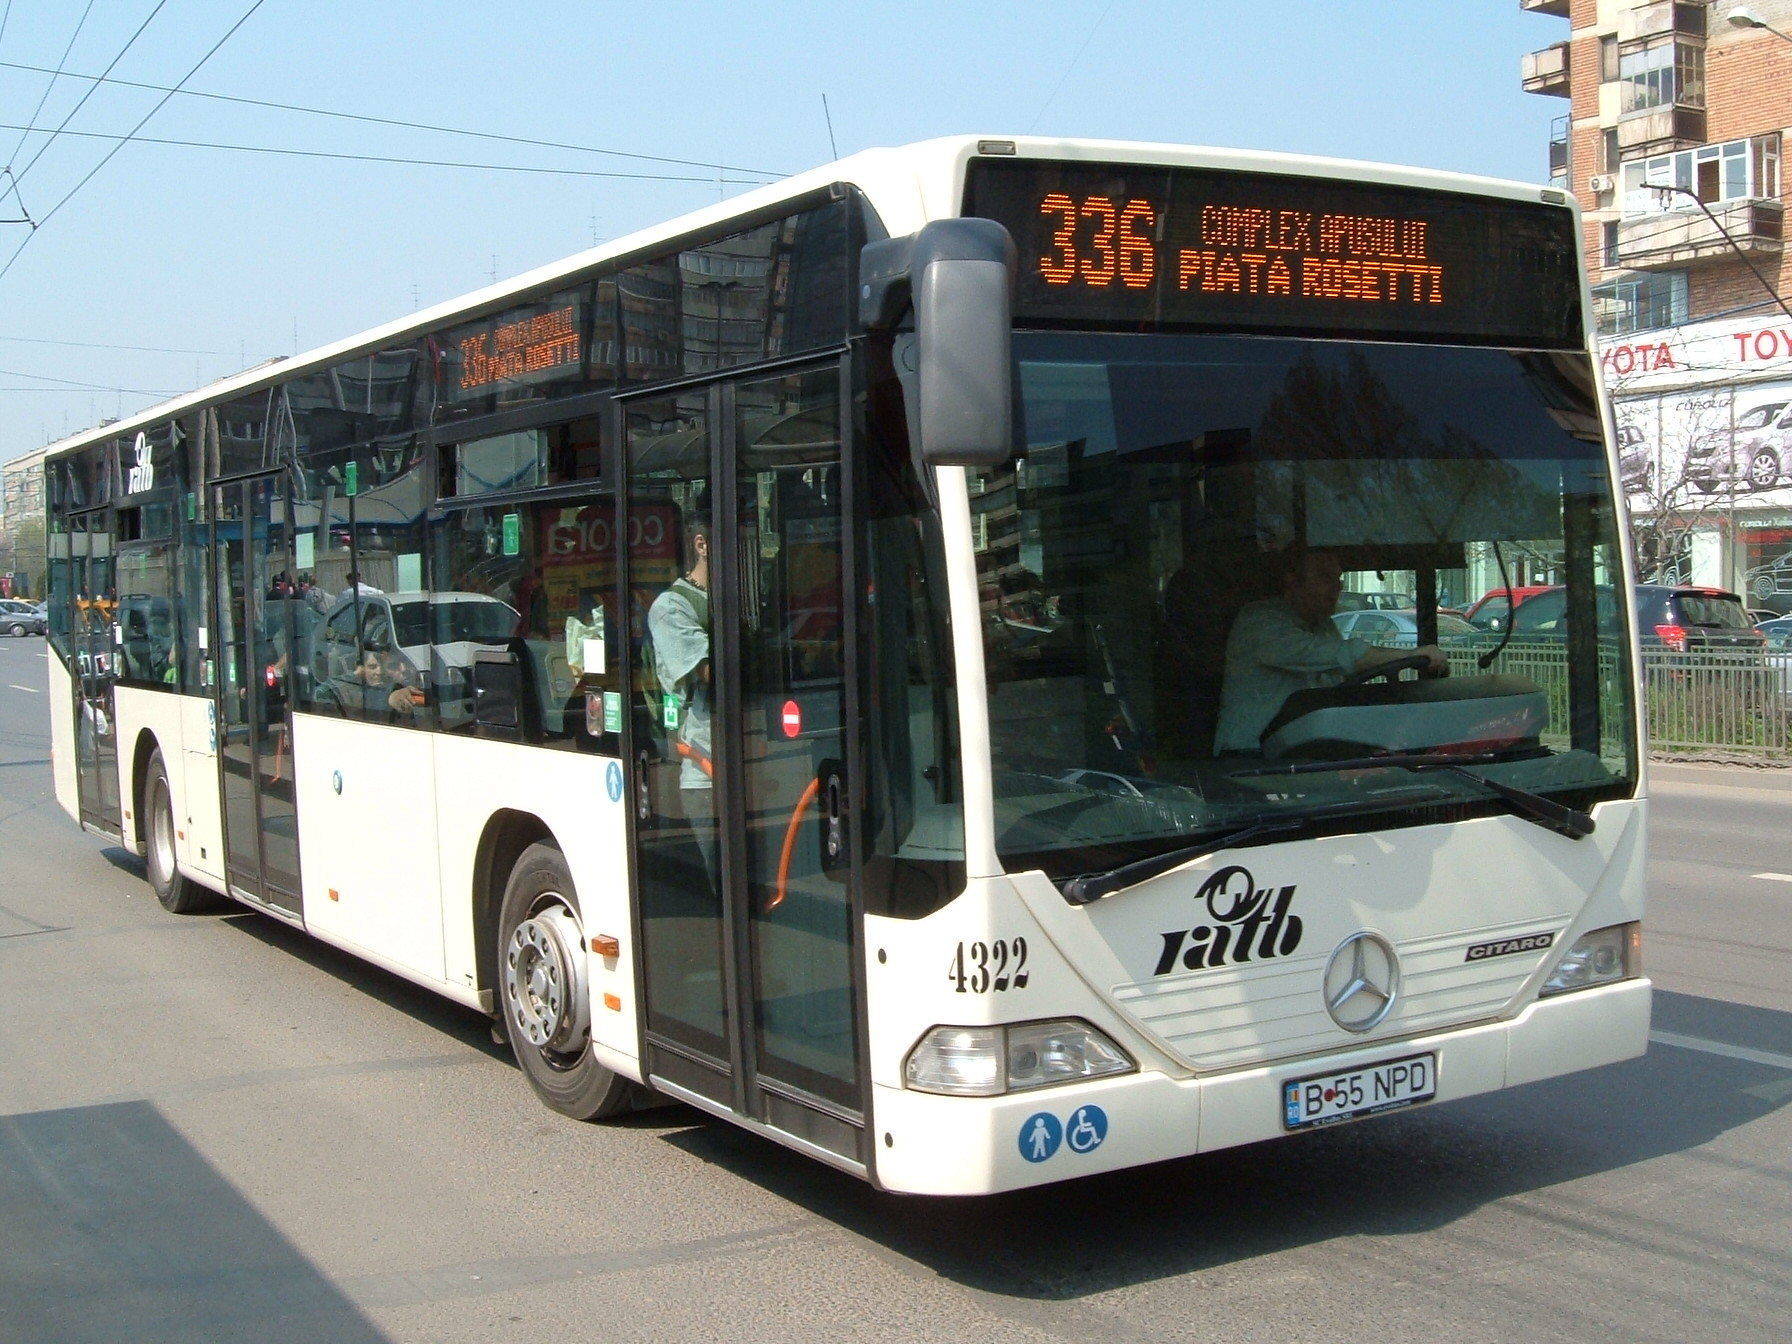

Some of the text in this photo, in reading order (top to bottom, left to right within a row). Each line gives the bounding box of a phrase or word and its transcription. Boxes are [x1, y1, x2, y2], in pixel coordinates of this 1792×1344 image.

[1040, 193, 1155, 289] 336
[1202, 205, 1311, 251] COMPLEX
[1179, 248, 1443, 303] PIATA ROSETTI
[949, 936, 1029, 994] 4322
[1469, 935, 1551, 958] CITARO
[1306, 1062, 1425, 1116] B 55 NPD
